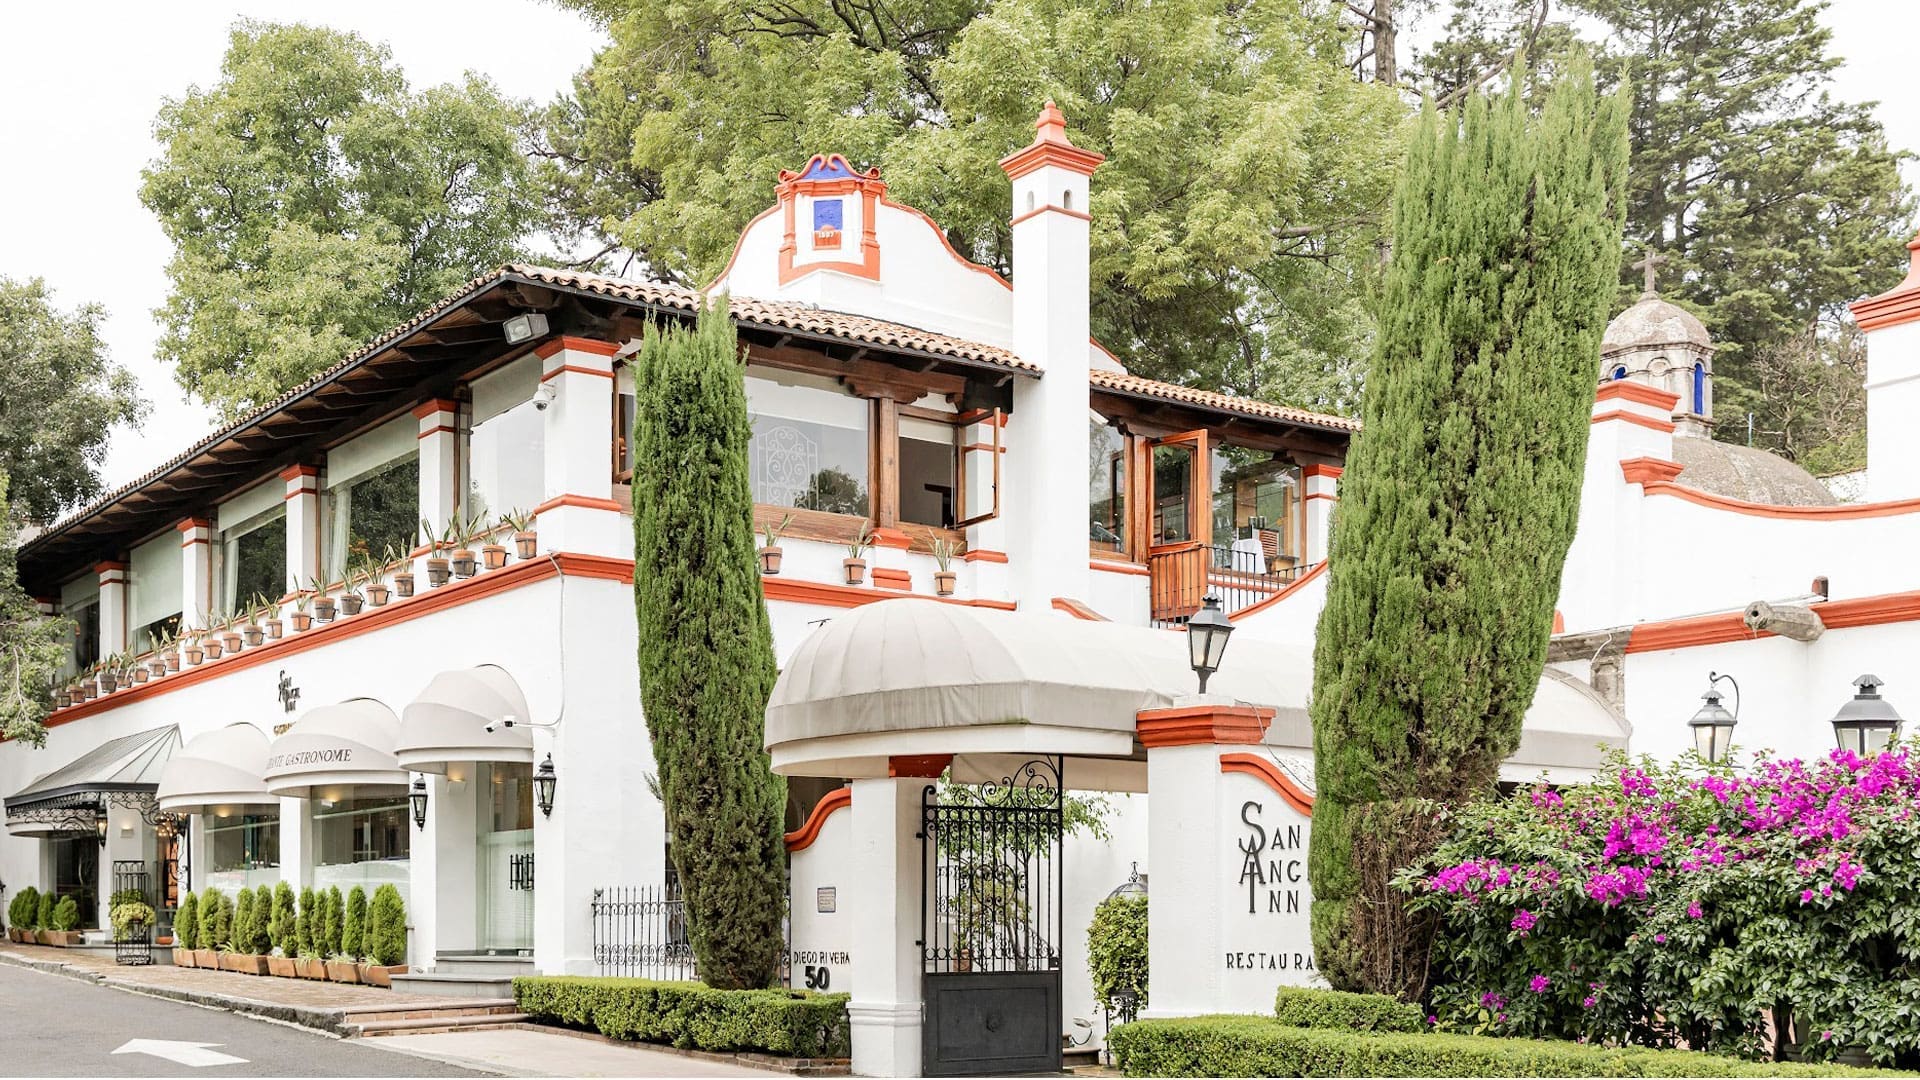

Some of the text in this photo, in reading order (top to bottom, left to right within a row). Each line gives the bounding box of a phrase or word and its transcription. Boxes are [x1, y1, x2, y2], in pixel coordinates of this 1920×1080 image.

[285, 749, 352, 766] GASTRONOME
[1239, 801, 1301, 855] SAN
[1239, 834, 1312, 885] ANG
[1249, 861, 1300, 914] INN
[793, 951, 850, 965] DIEGO RIVERA
[1226, 952, 1314, 970] RESTAURA
[804, 965, 831, 990] 50
